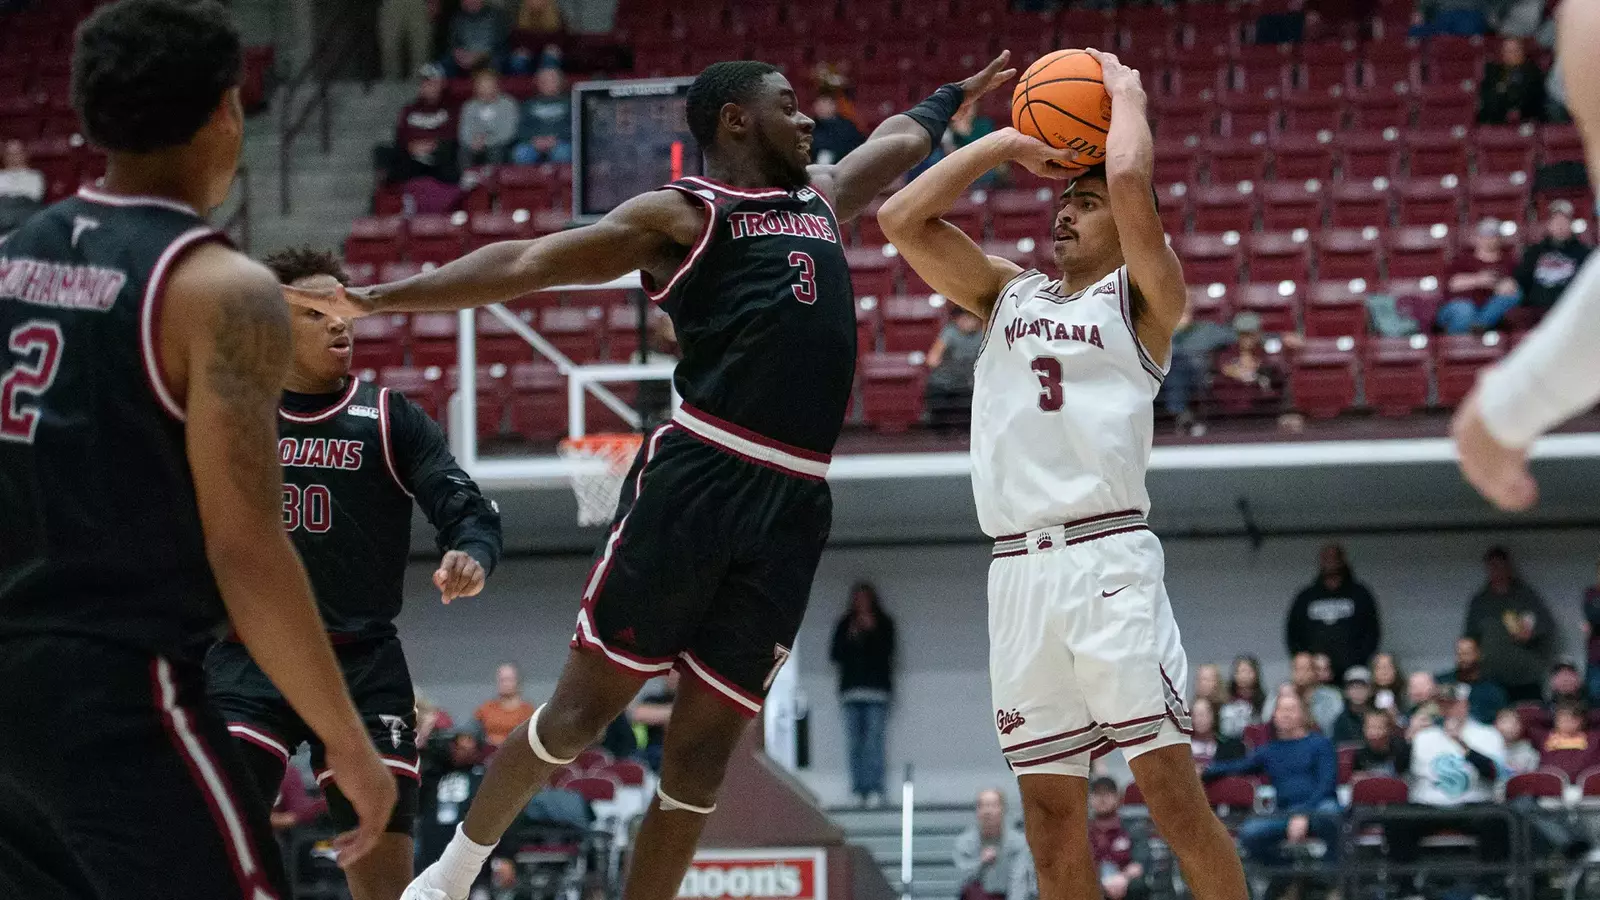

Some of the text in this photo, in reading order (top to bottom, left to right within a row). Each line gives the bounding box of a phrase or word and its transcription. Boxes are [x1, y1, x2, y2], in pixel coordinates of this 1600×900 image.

[727, 209, 837, 243] TROJANS
[787, 250, 818, 306] 3
[0, 319, 64, 444] 2
[1029, 354, 1065, 415] 3
[279, 437, 364, 471] OJANS
[281, 483, 332, 533] 30
[996, 707, 1024, 732] Griz
